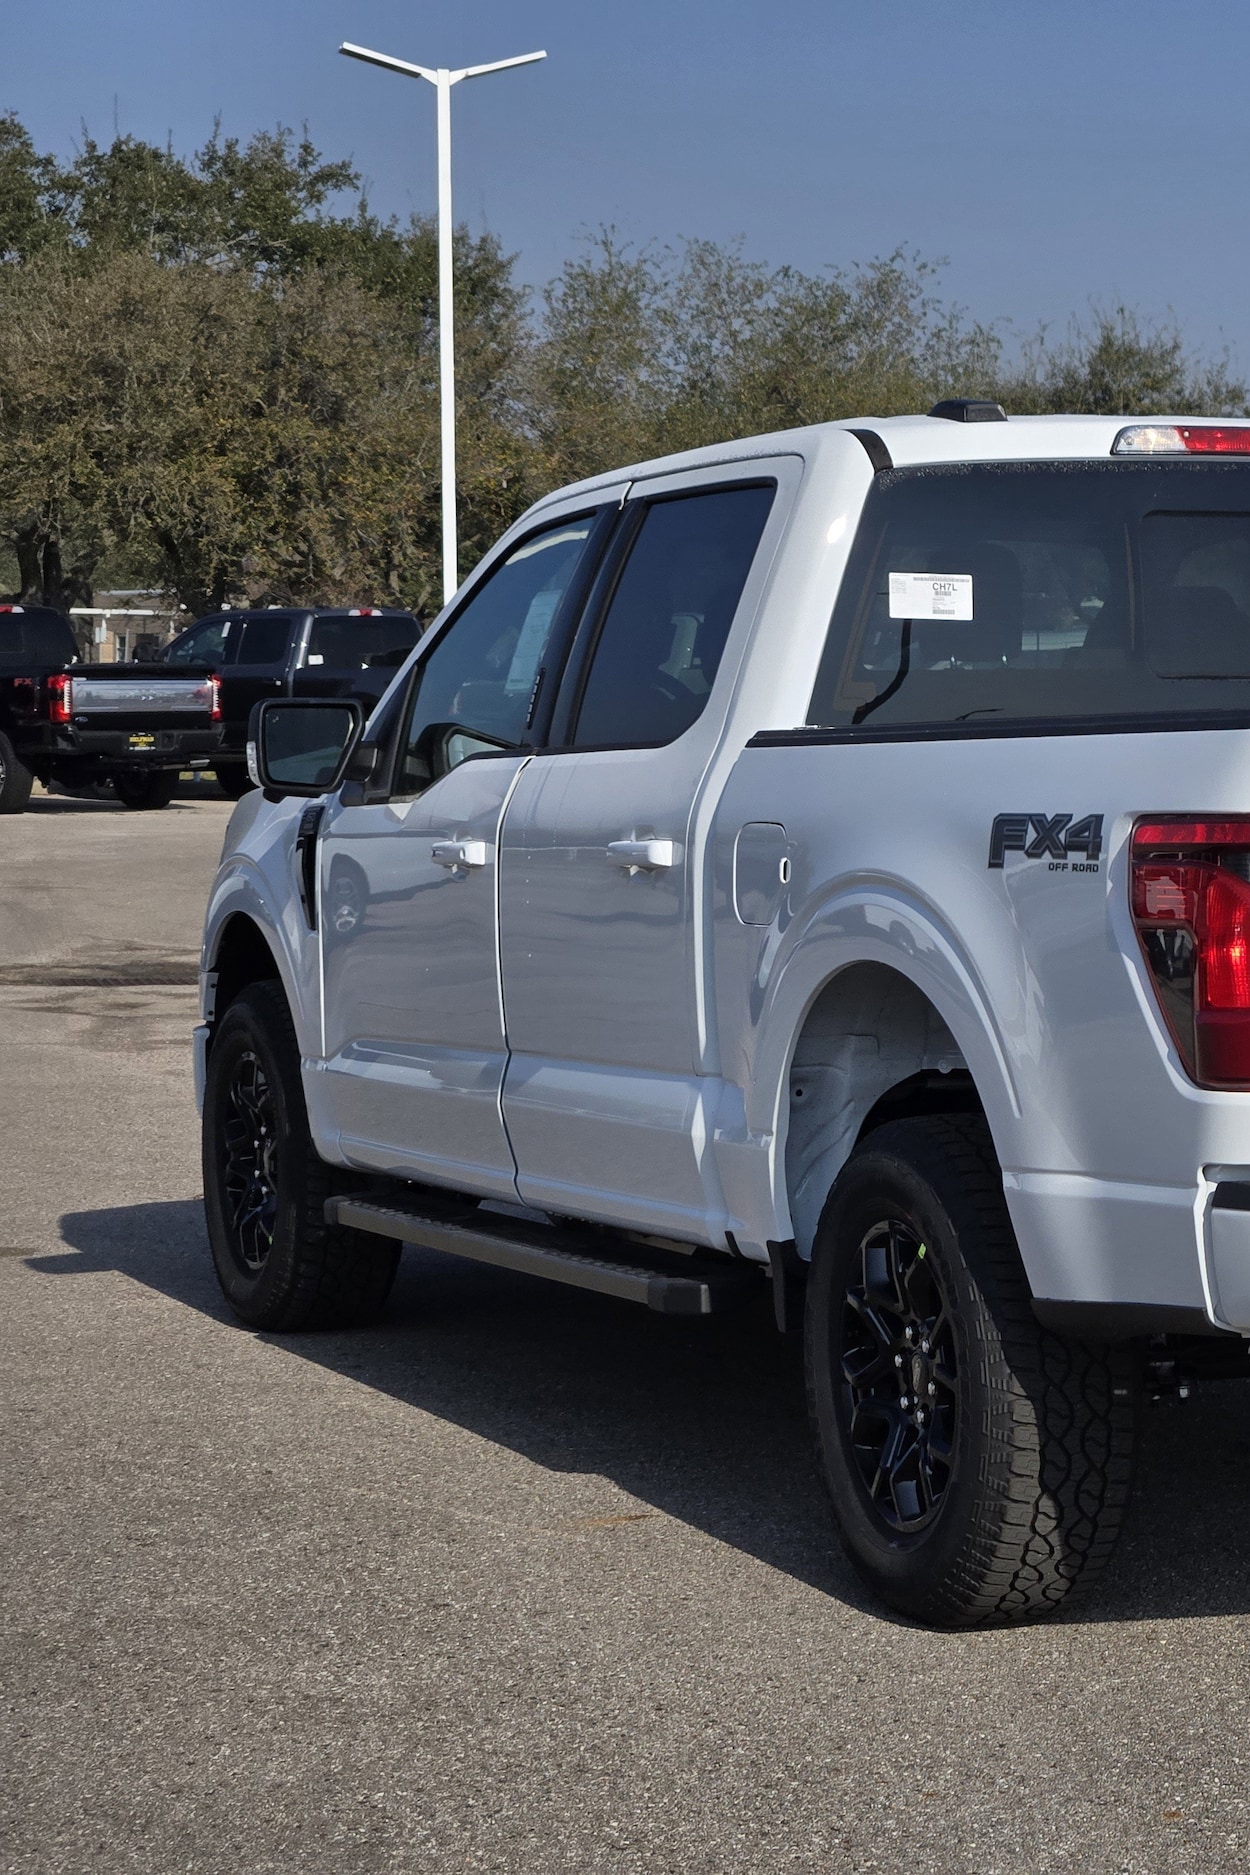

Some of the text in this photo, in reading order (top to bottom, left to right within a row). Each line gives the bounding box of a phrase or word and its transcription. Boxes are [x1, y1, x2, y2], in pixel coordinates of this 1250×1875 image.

[932, 582, 958, 592] CH7L
[988, 813, 1104, 869] FX4
[1048, 862, 1099, 873] OFF ROAD
